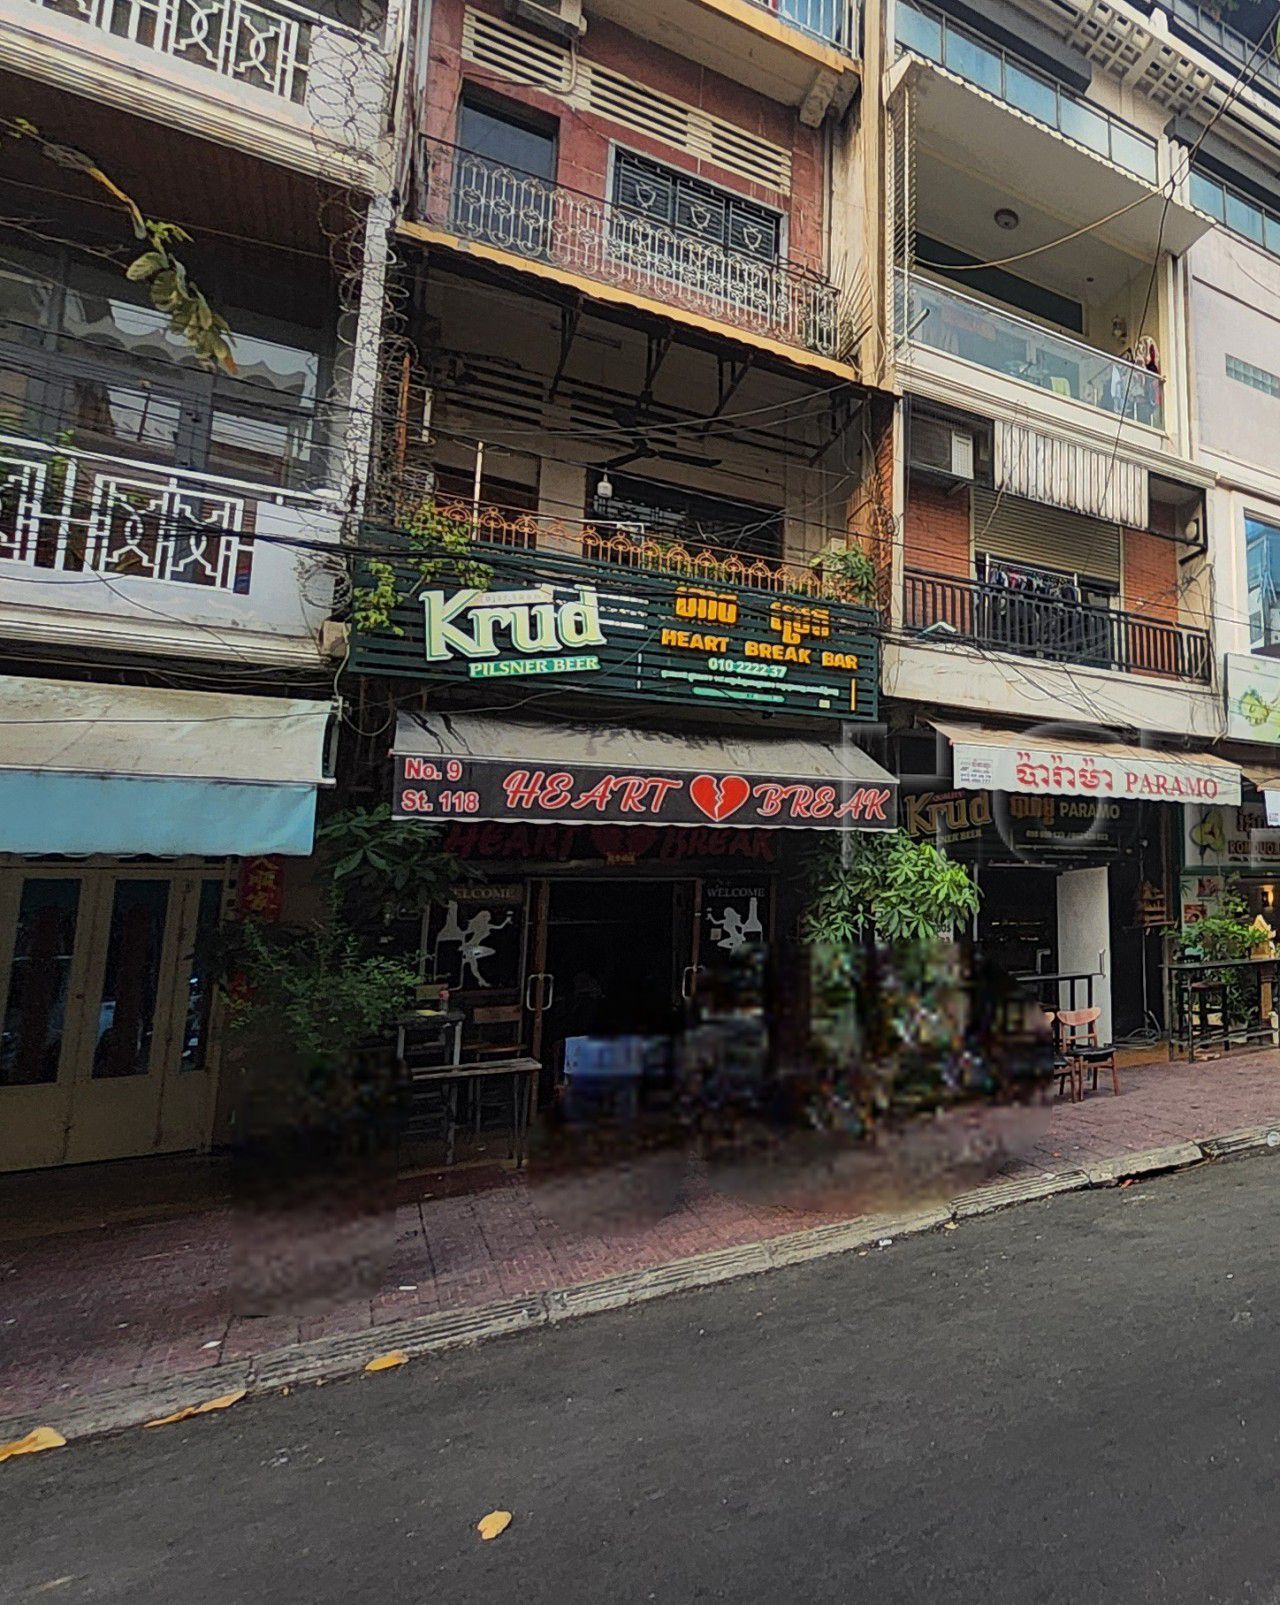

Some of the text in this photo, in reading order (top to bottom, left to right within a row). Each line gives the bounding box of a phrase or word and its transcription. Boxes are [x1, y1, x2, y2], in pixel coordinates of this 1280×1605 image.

[418, 584, 607, 662] Krud
[661, 628, 858, 670] HEART BREAK BAR
[469, 655, 599, 678] PILSNER BEER
[404, 757, 462, 781] No. 9
[503, 769, 891, 820] HEART BREAK
[1124, 771, 1219, 799] PARAMO
[401, 789, 479, 813] St. 118
[904, 789, 992, 838] Krud
[1059, 801, 1120, 820] PARAMO
[706, 887, 766, 898] WELCOME
